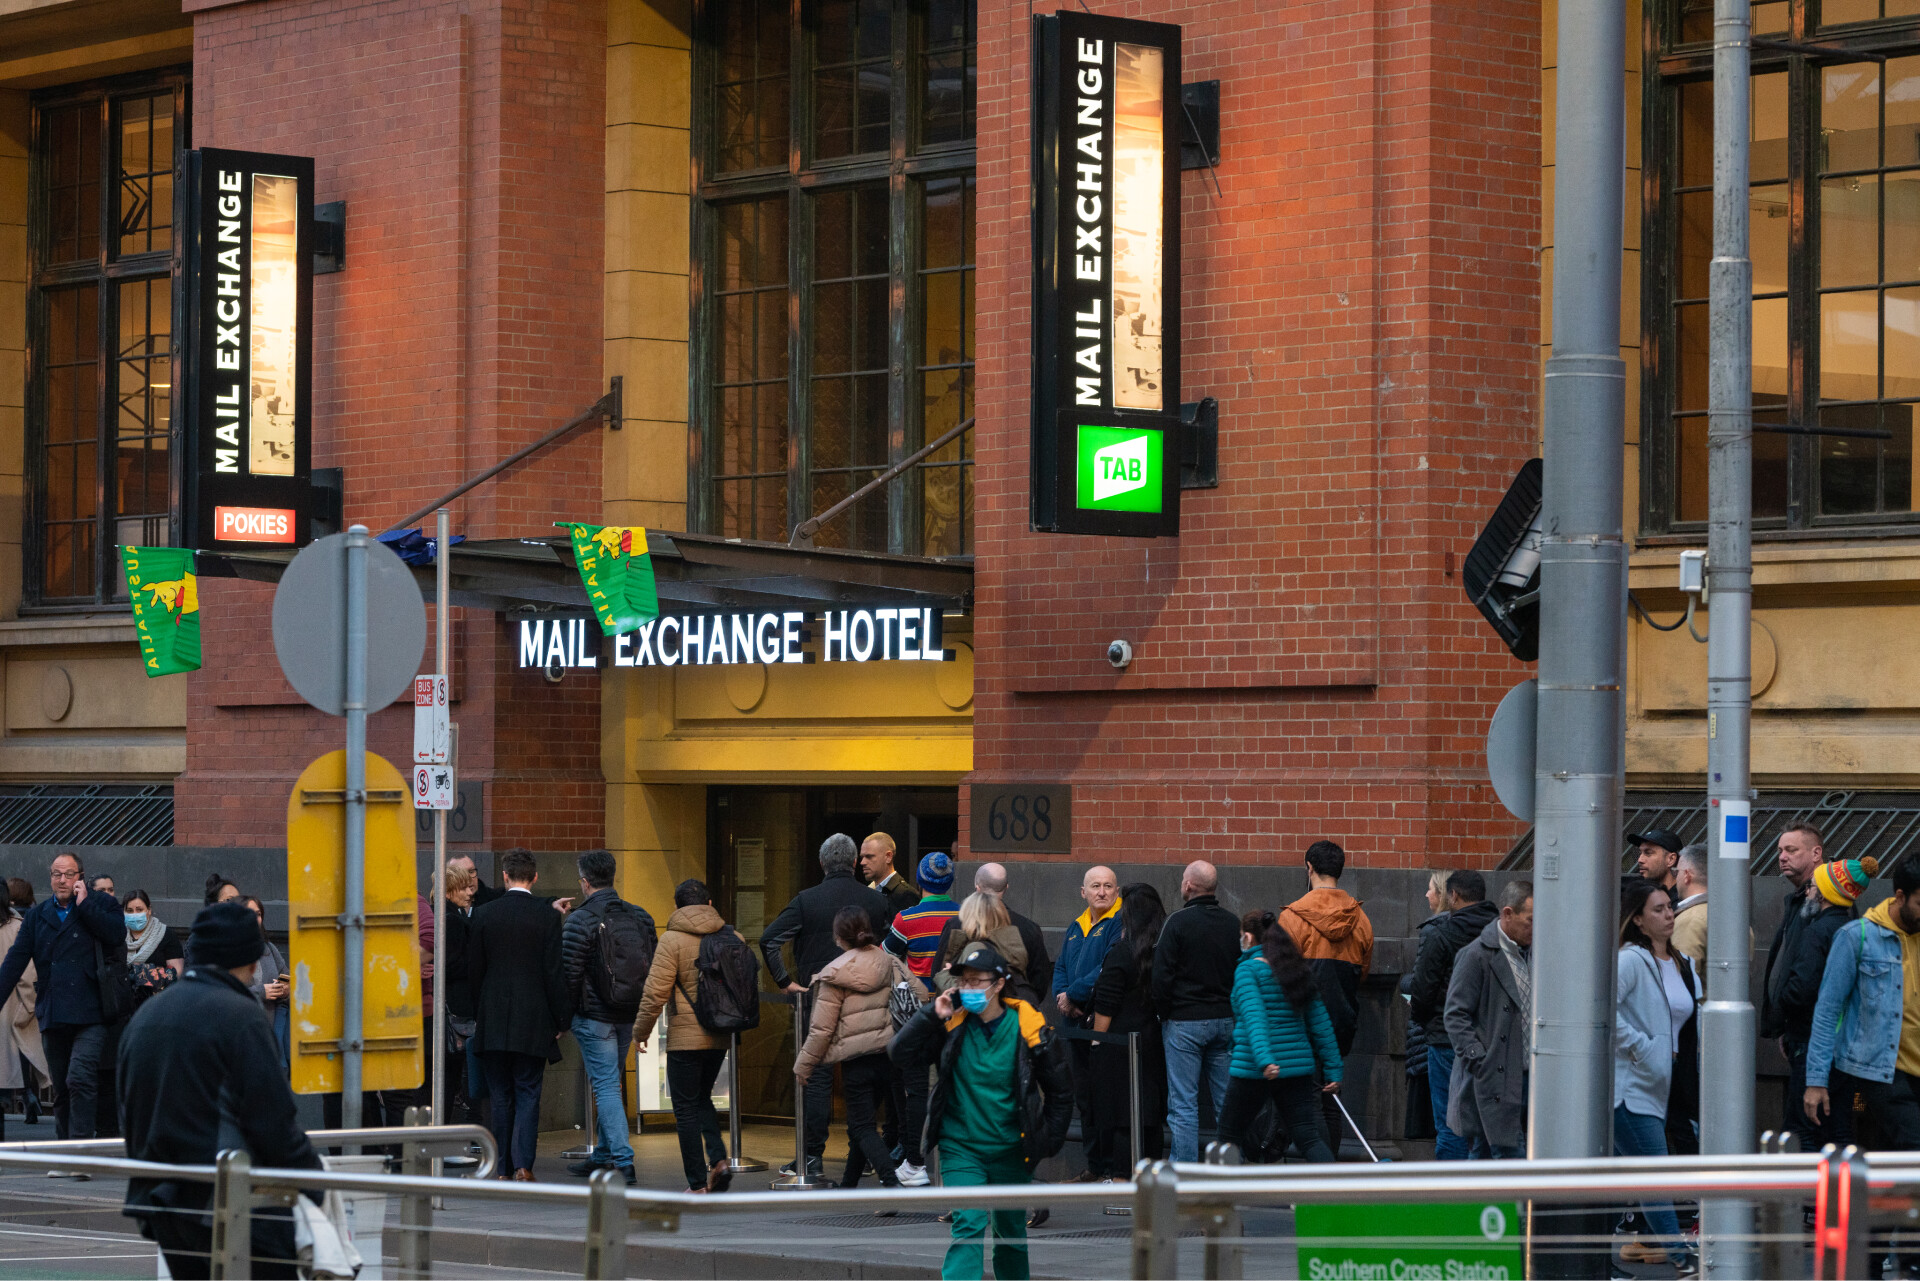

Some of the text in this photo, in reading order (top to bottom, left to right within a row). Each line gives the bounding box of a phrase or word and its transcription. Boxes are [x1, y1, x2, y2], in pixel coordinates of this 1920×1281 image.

[1076, 38, 1103, 406] MAIL EXCHANGE
[215, 170, 242, 473] MAIL EXCHANGE
[1100, 456, 1142, 482] TAB
[222, 511, 288, 536] POKIES
[520, 607, 944, 669] MAIL EXCHANGE HOTEL
[418, 681, 431, 692] BUS
[417, 694, 433, 706] ZONE
[988, 795, 1052, 842] 688
[1309, 1257, 1510, 1281] Southern Cross Station
